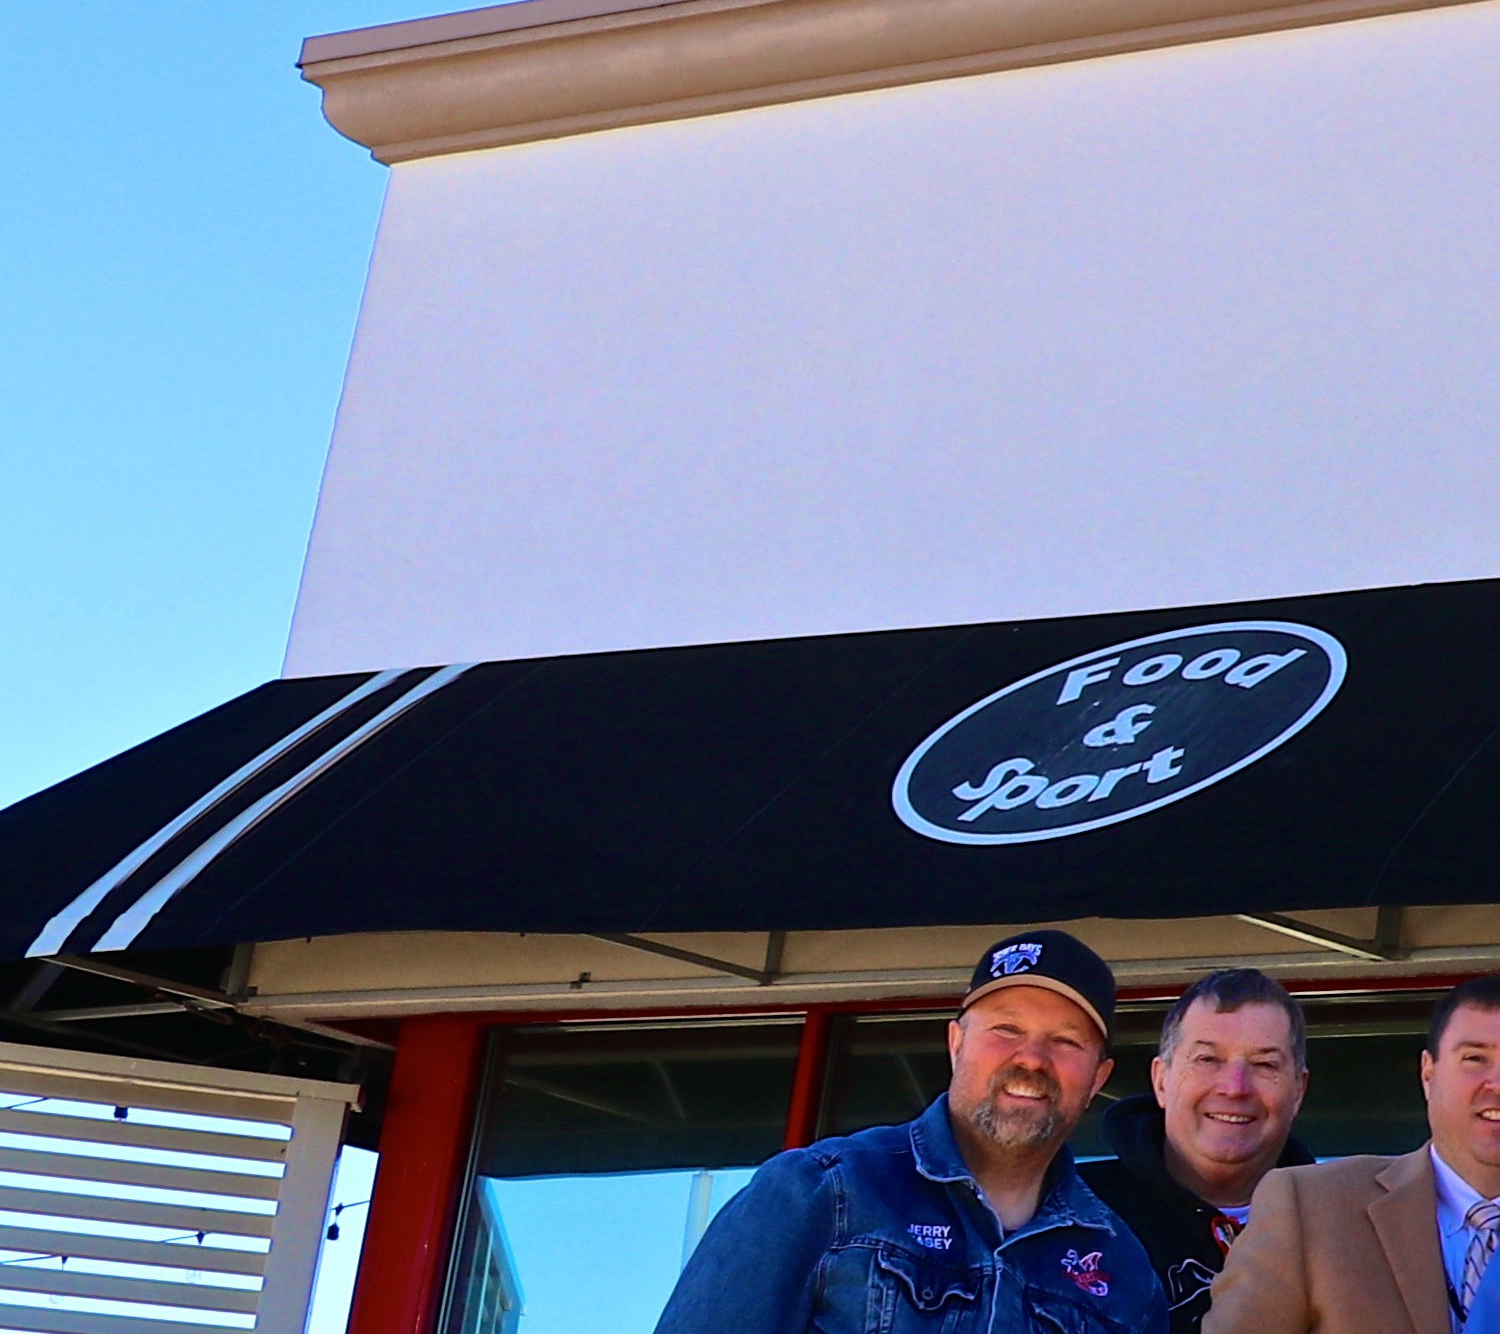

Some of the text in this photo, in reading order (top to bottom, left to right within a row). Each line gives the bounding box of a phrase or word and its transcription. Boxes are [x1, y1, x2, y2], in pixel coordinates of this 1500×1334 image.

[1056, 648, 1308, 705] Food
[1083, 704, 1156, 747] &
[952, 746, 1184, 822] Sport
[907, 1223, 951, 1237] JERRY
